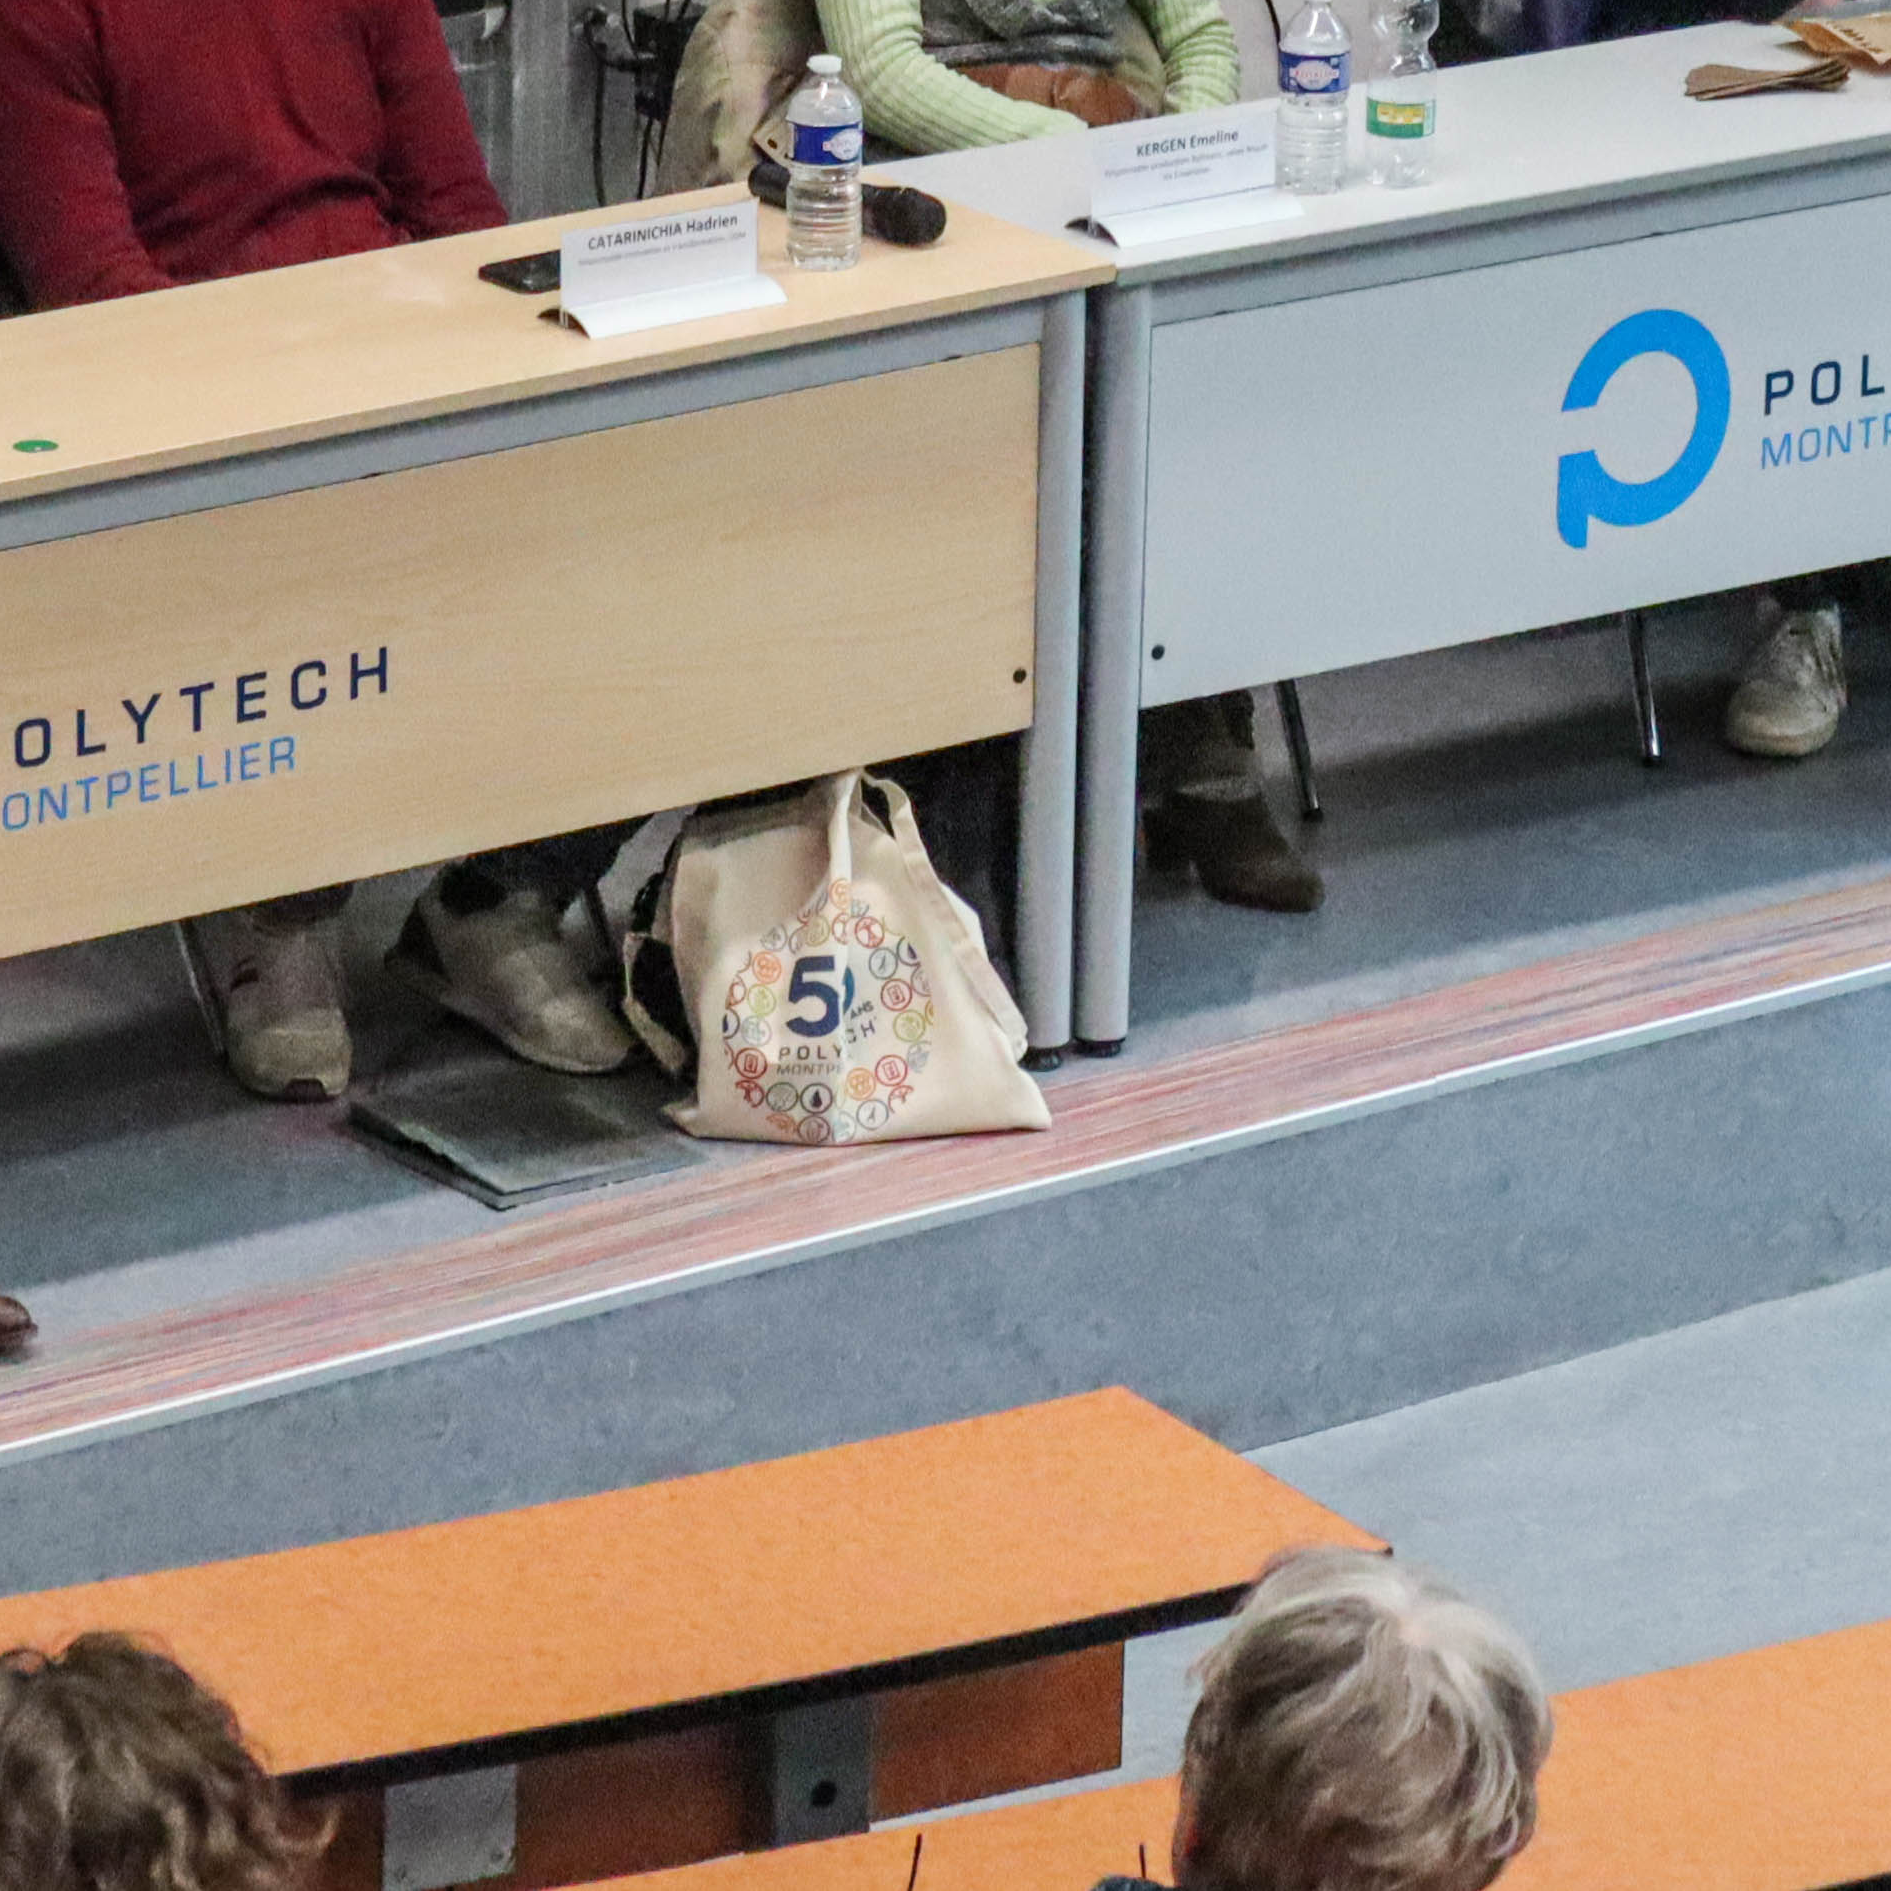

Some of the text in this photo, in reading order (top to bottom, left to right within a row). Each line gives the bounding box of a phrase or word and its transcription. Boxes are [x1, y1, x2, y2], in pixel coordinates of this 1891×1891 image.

[1136, 137, 1186, 157] KERGEN
[1190, 130, 1239, 148] Emeline
[588, 223, 682, 250] CATARINICHIA
[686, 215, 738, 232] Hadrien
